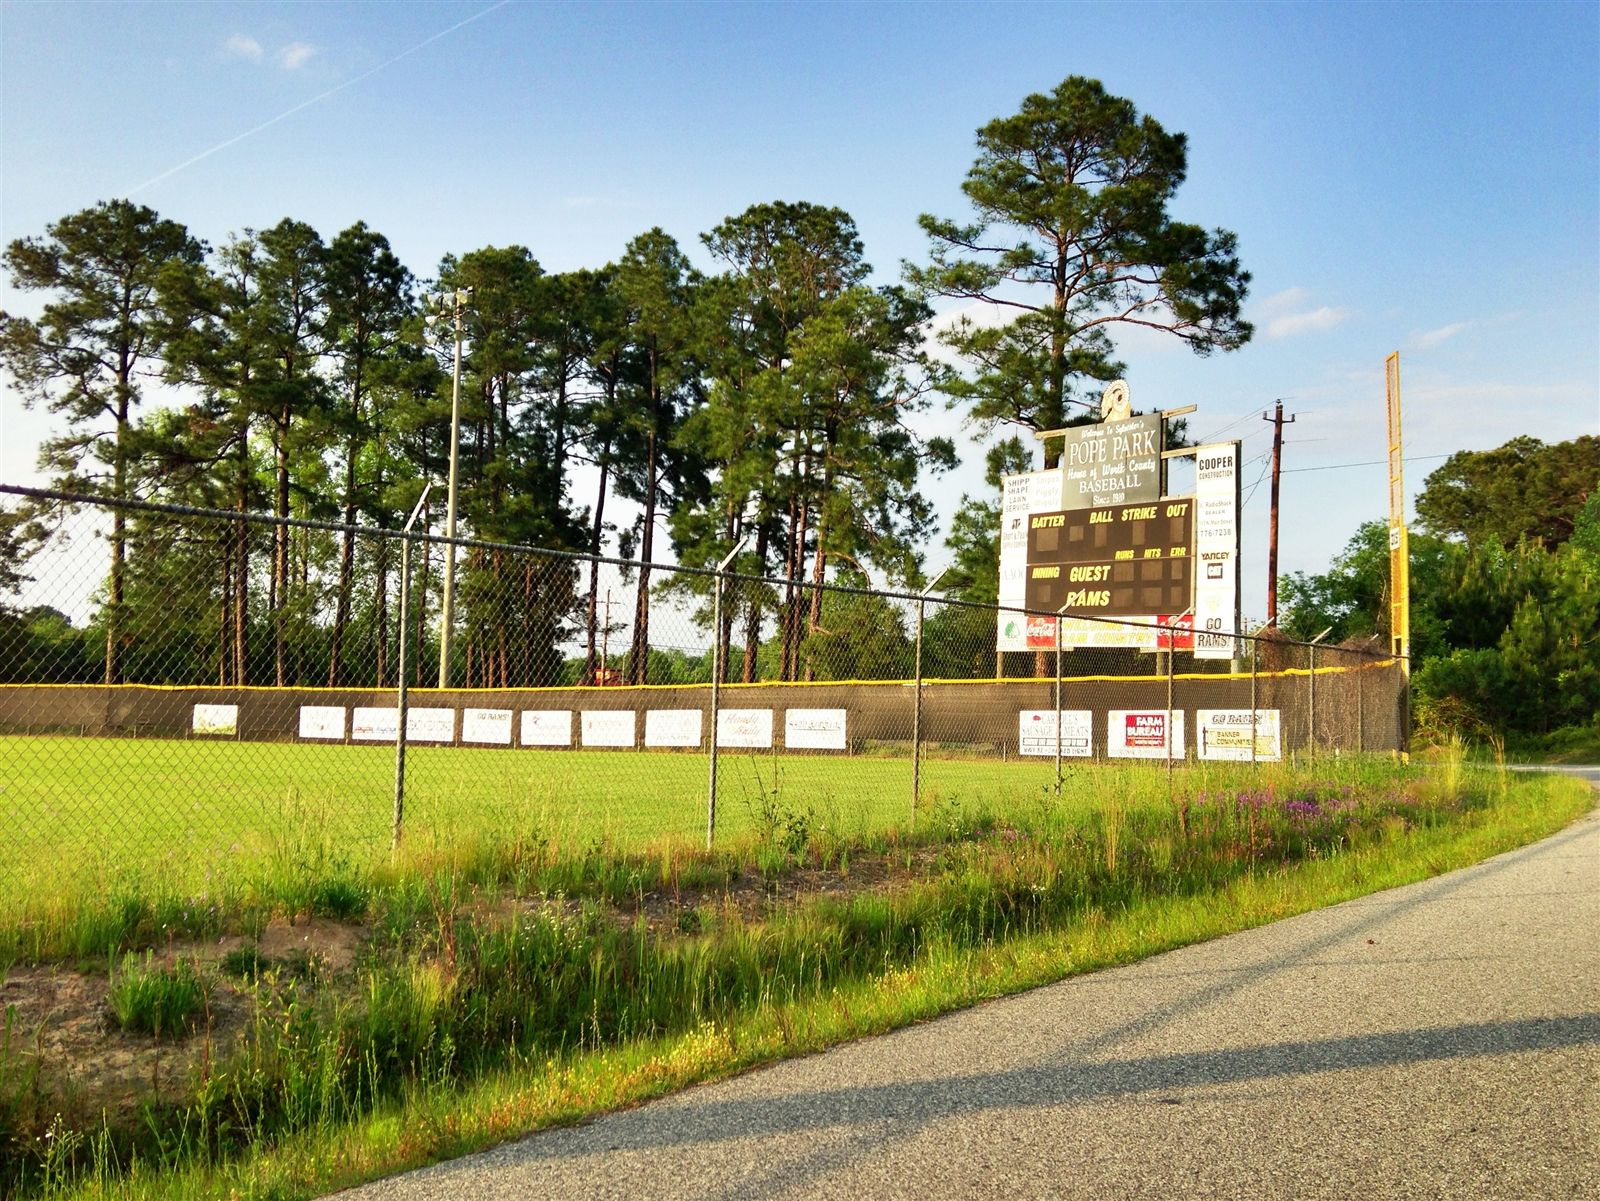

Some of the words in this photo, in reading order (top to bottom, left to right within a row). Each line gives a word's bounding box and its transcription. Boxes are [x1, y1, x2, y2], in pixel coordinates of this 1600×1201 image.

[1069, 438, 1107, 466] POPE
[1112, 429, 1156, 460] PARK
[1199, 455, 1233, 471] COOPER
[1199, 469, 1233, 480] CONSTRUCTION
[1007, 477, 1031, 488] SHIPP
[1079, 473, 1142, 494] BASEBALL
[1005, 502, 1030, 513] SERVICE
[1031, 515, 1065, 529] BATTER
[1089, 510, 1114, 524] BALL
[1121, 506, 1158, 522] STRIKE
[1166, 503, 1188, 518] OUT
[1115, 549, 1134, 560] RUNS
[1144, 548, 1161, 558] HITS
[1170, 547, 1186, 557] ERR
[1201, 552, 1230, 560] YANCEY
[1032, 566, 1060, 579] INNING
[1070, 565, 1111, 582] GUEST
[1066, 590, 1111, 607] RAMS
[1206, 617, 1222, 630] GO
[1136, 716, 1163, 726] FARM
[1212, 714, 1226, 724] GO
[1022, 725, 1053, 736] SAUSAGE
[1063, 725, 1089, 737] MEATS
[1126, 726, 1163, 736] BUREAU
